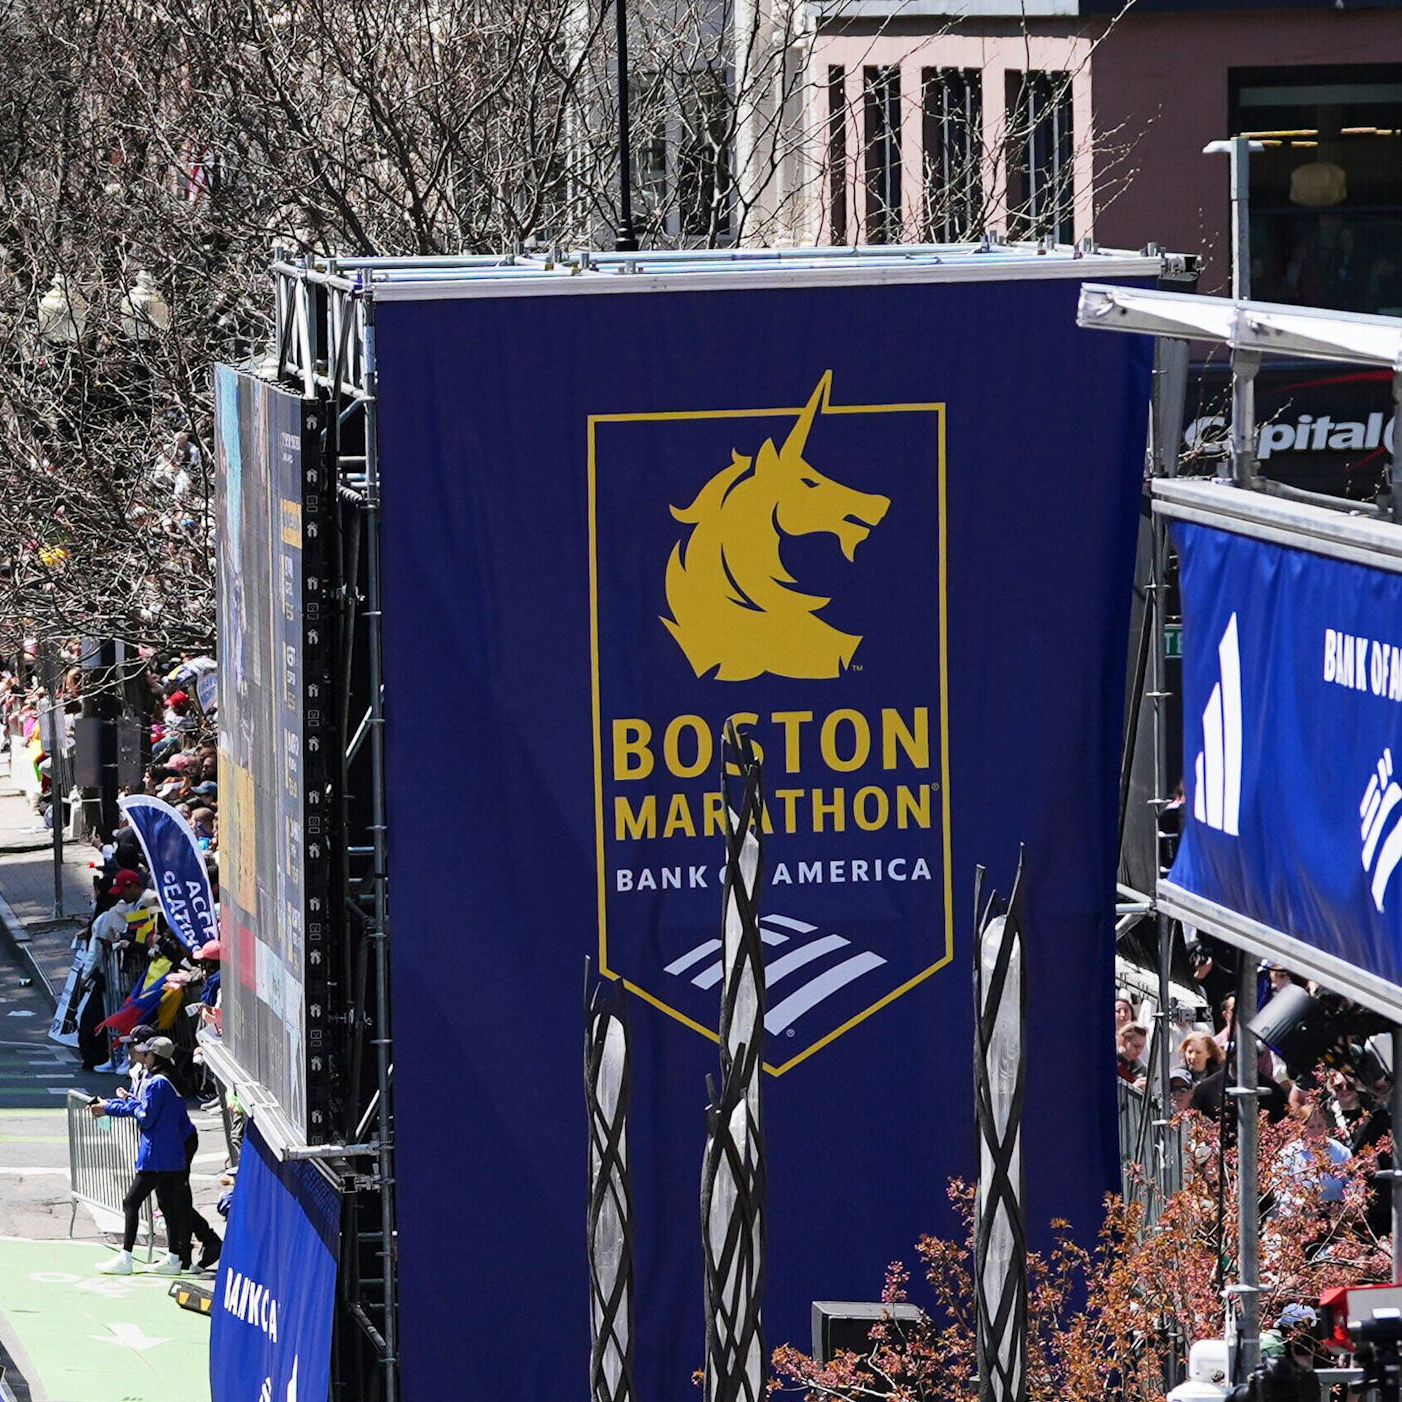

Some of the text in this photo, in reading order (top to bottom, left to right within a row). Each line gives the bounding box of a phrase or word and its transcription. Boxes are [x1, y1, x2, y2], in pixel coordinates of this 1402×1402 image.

[1185, 413, 1381, 459] Cpital
[1324, 629, 1368, 687] BANK
[612, 707, 930, 781] BOSTON
[616, 858, 932, 893] BANK AMERICA
